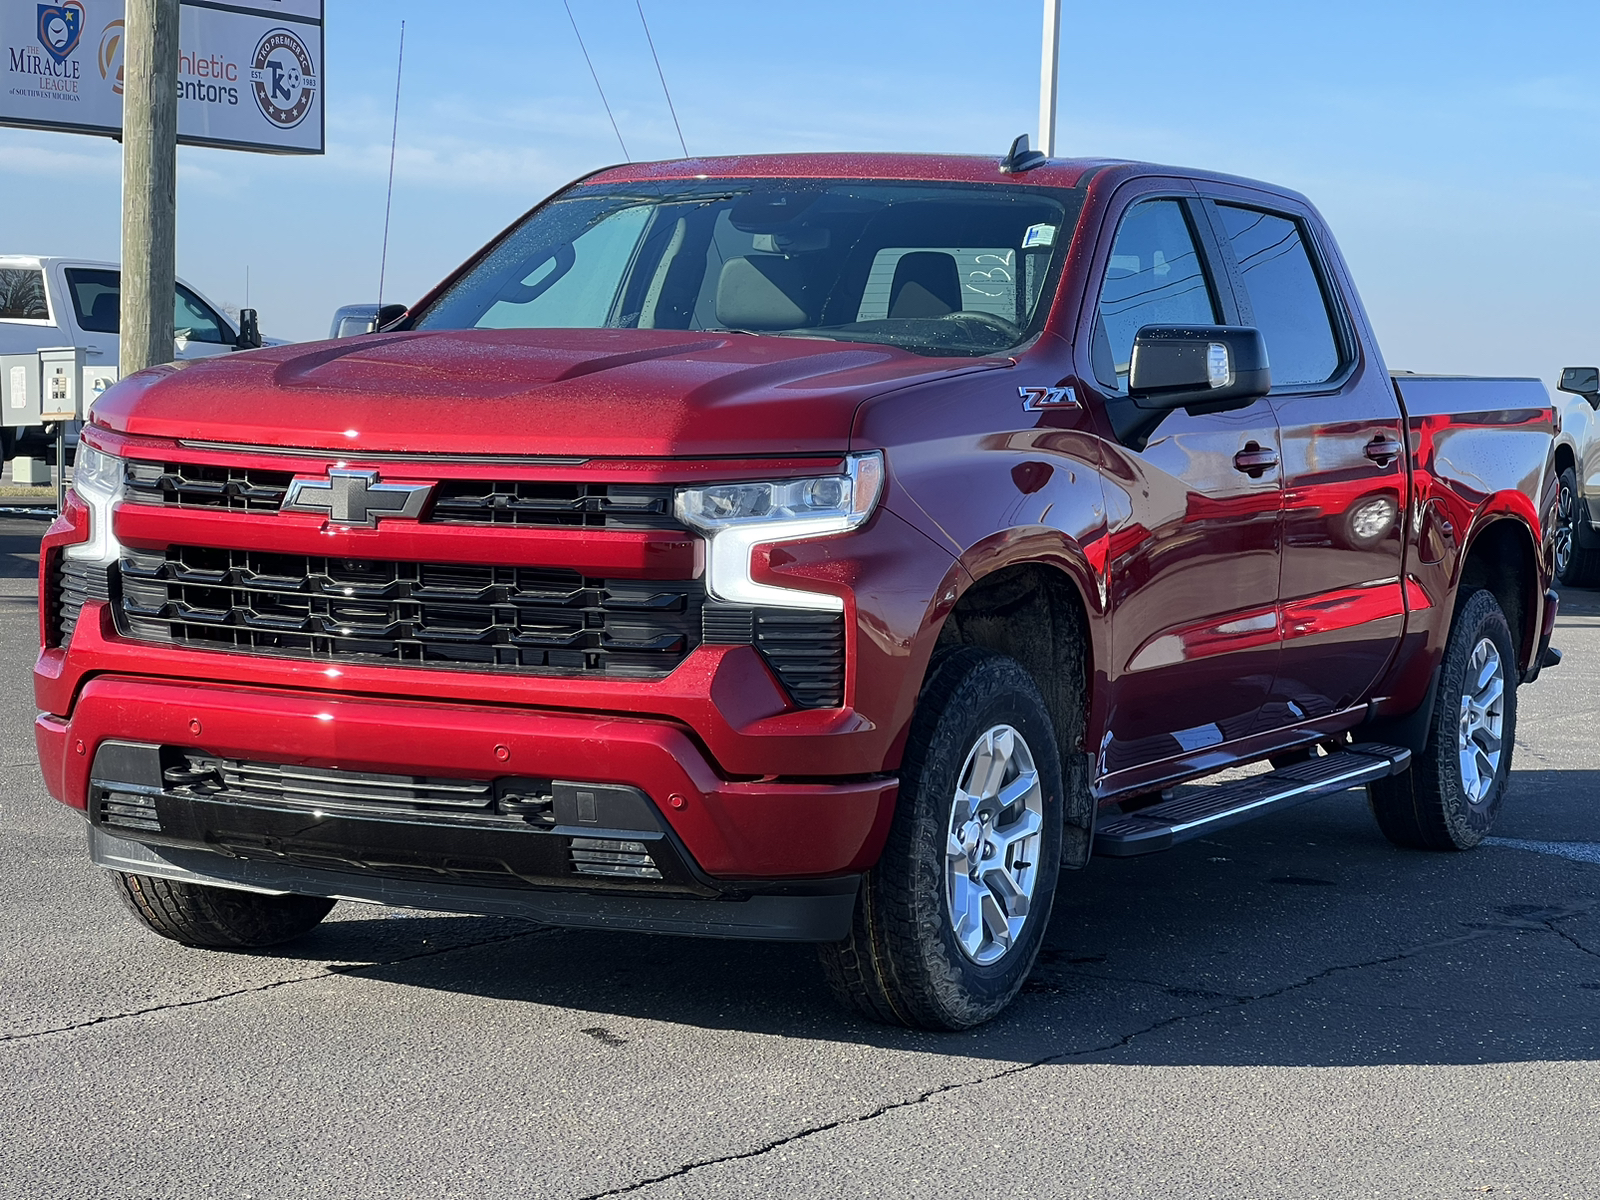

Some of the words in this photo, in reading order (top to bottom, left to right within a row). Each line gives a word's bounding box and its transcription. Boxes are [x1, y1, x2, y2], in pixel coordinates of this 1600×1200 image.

[27, 46, 39, 54] THE
[258, 43, 270, 61] TKO
[271, 36, 301, 54] PREMIER
[299, 55, 308, 68] SC
[9, 47, 80, 79] MIRACLE
[178, 49, 238, 82] hletic
[40, 77, 78, 92] LEAGUE
[251, 70, 263, 80] EST.
[303, 78, 316, 87] 1983
[16, 89, 50, 98] SOUTHWEST
[52, 93, 80, 101] MICHIGAN
[177, 80, 239, 106] entors
[1018, 386, 1081, 412] Z71
